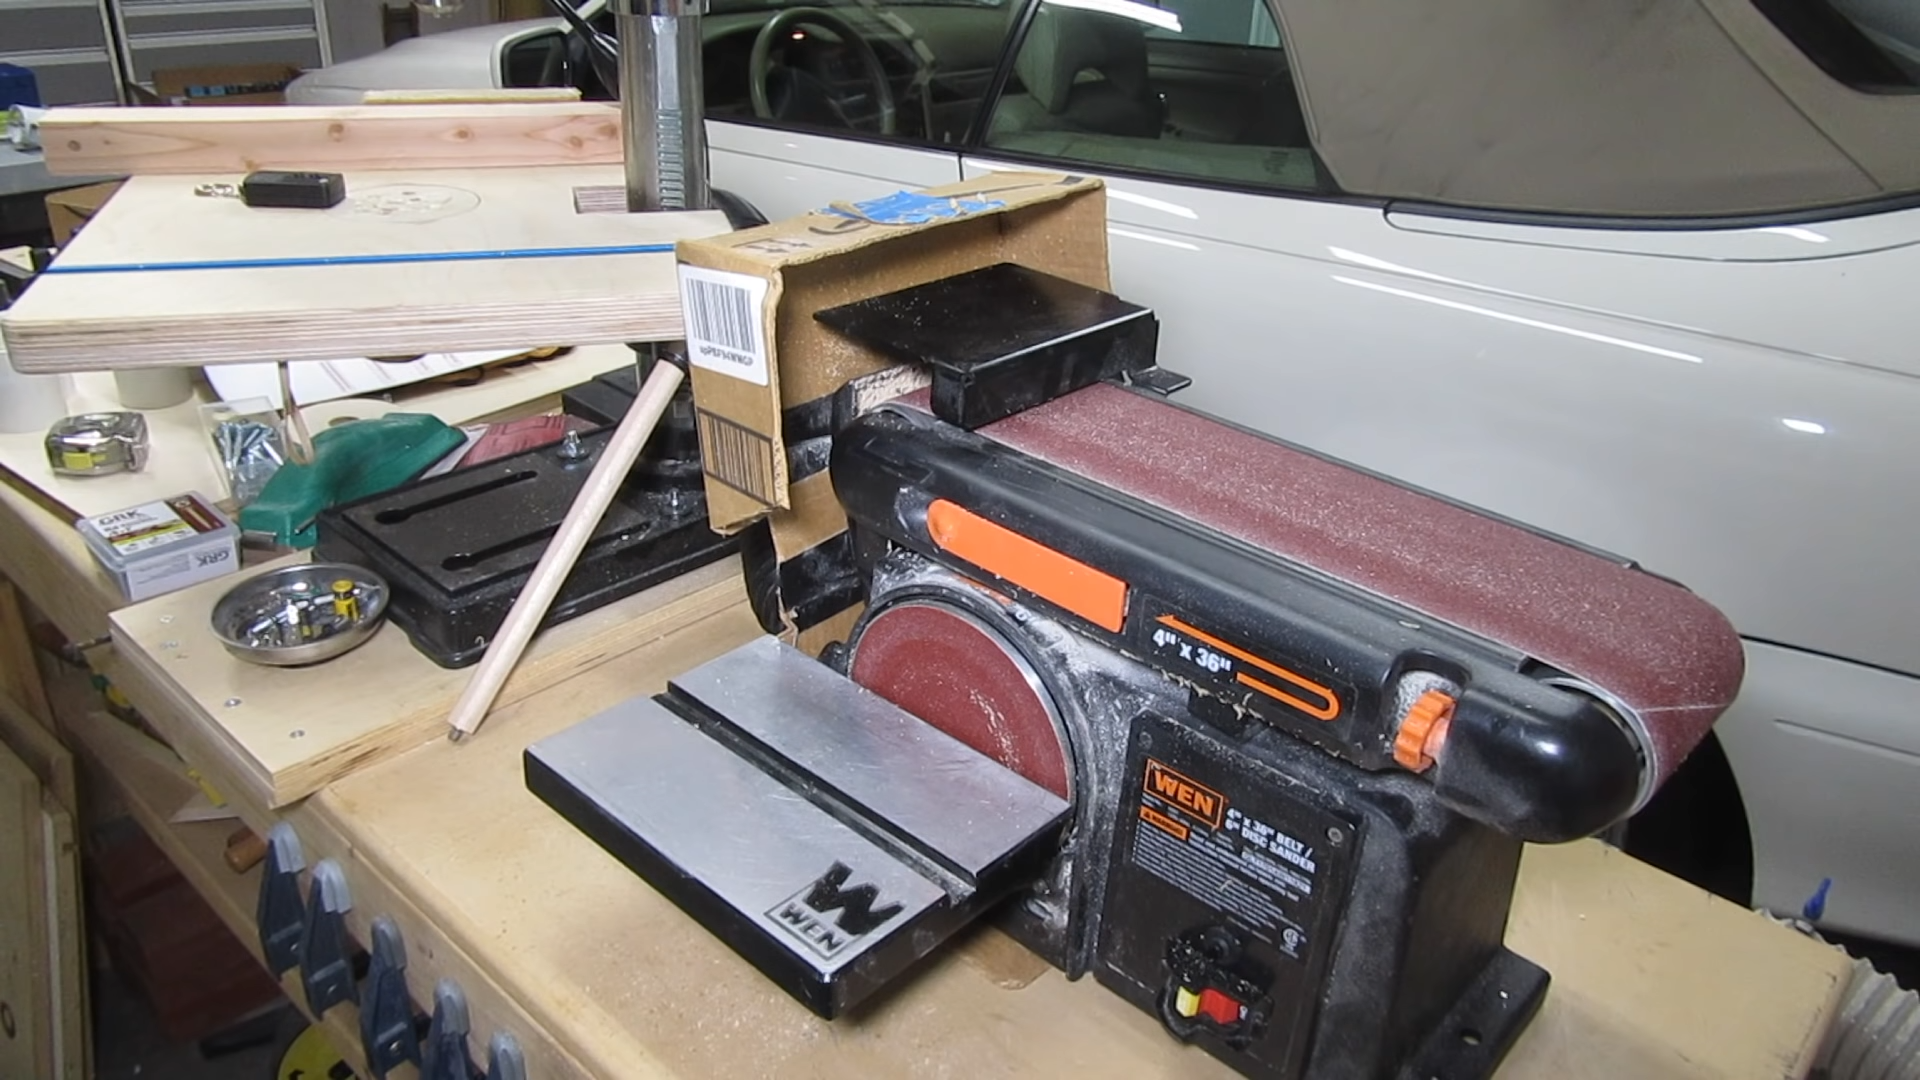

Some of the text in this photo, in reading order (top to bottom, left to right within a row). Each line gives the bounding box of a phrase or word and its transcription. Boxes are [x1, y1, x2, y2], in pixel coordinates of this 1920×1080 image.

[99, 509, 138, 525] GRK
[195, 550, 230, 568] GRK
[1153, 628, 1177, 647] 4"
[1195, 647, 1232, 673] 36"
[1153, 770, 1214, 817] WEN
[1241, 826, 1269, 849] DISC
[1268, 840, 1317, 874] SANDER
[1276, 832, 1304, 854] BELT
[779, 901, 845, 951] WEN
